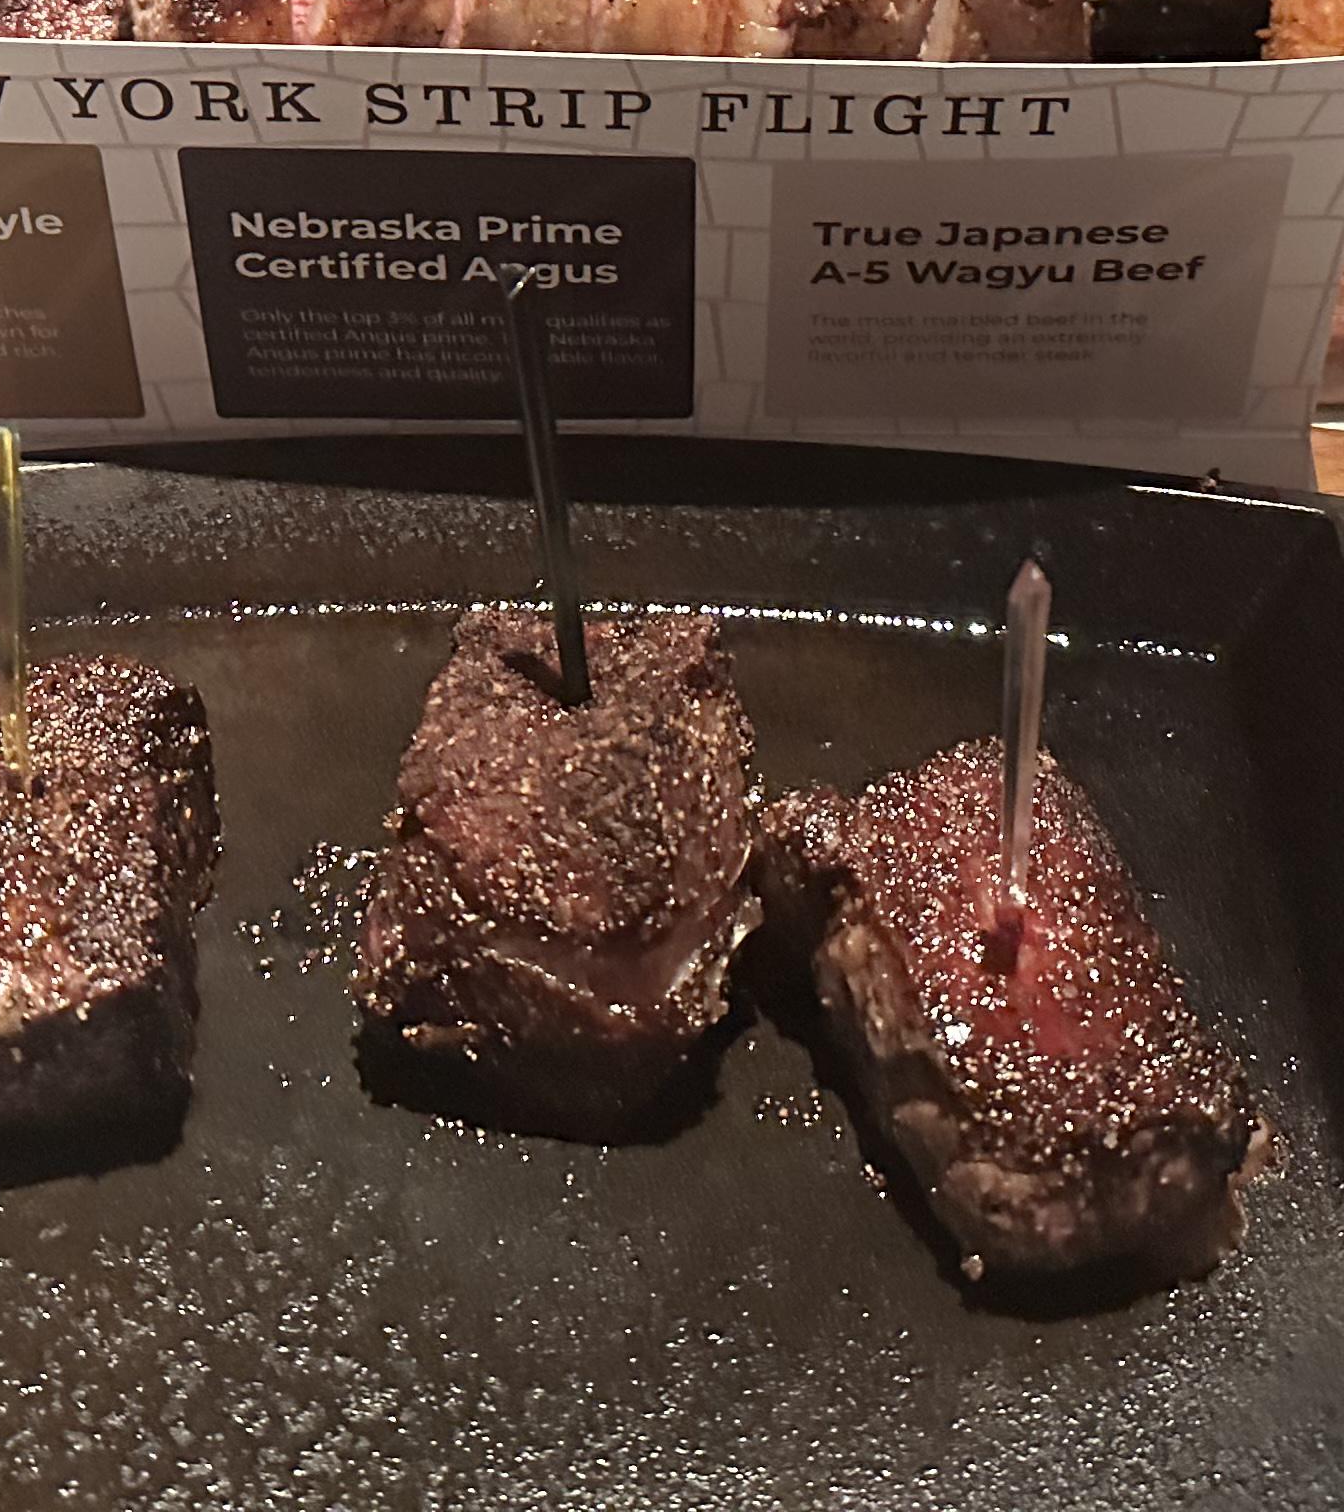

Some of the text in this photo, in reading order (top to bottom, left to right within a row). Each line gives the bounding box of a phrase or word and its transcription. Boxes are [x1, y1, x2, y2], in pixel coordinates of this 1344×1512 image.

[53, 77, 323, 124] YORK
[365, 83, 654, 131] STRIP
[701, 92, 1071, 137] FLIGHT
[230, 211, 624, 246] Nebraska Prime
[812, 221, 1169, 252] True Japanese
[234, 252, 448, 282] Certified
[809, 255, 1207, 290] A-5 Wagyu Beef
[240, 308, 295, 329] Only
[298, 308, 338, 325] the
[343, 310, 383, 329] top
